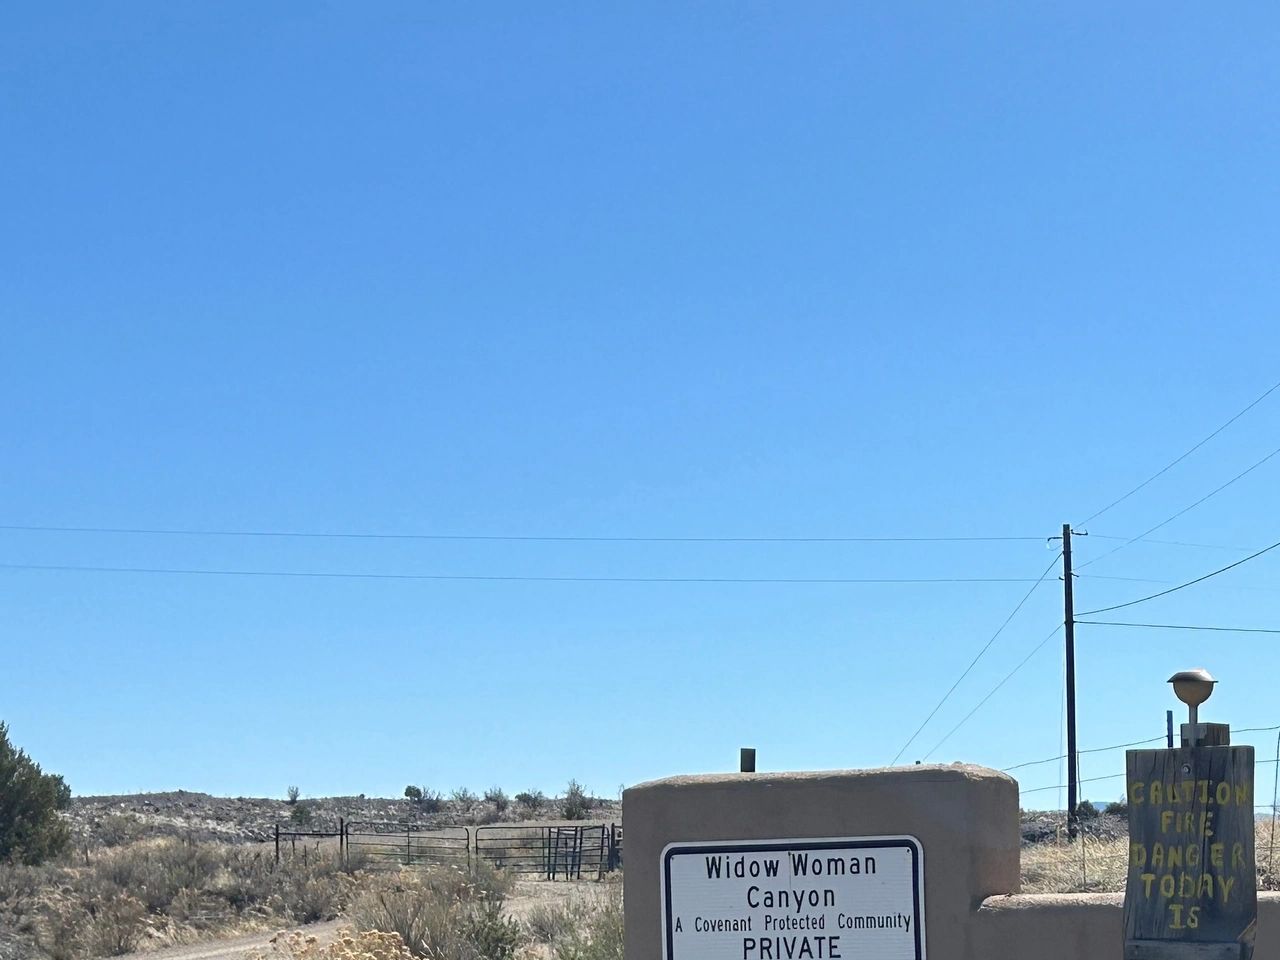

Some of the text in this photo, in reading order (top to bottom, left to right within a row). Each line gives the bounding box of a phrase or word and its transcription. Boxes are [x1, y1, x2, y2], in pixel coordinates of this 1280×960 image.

[1128, 781, 1249, 804] CAUTION
[1161, 811, 1214, 836] FIRE
[706, 854, 876, 879] Widow Woman
[1130, 842, 1245, 868] DANGER
[747, 886, 835, 913] Canyon
[1140, 872, 1234, 903] TODAY
[675, 913, 911, 933] A Covenant Protected Community
[1168, 904, 1201, 929] IS
[744, 936, 841, 960] PRIVATE
